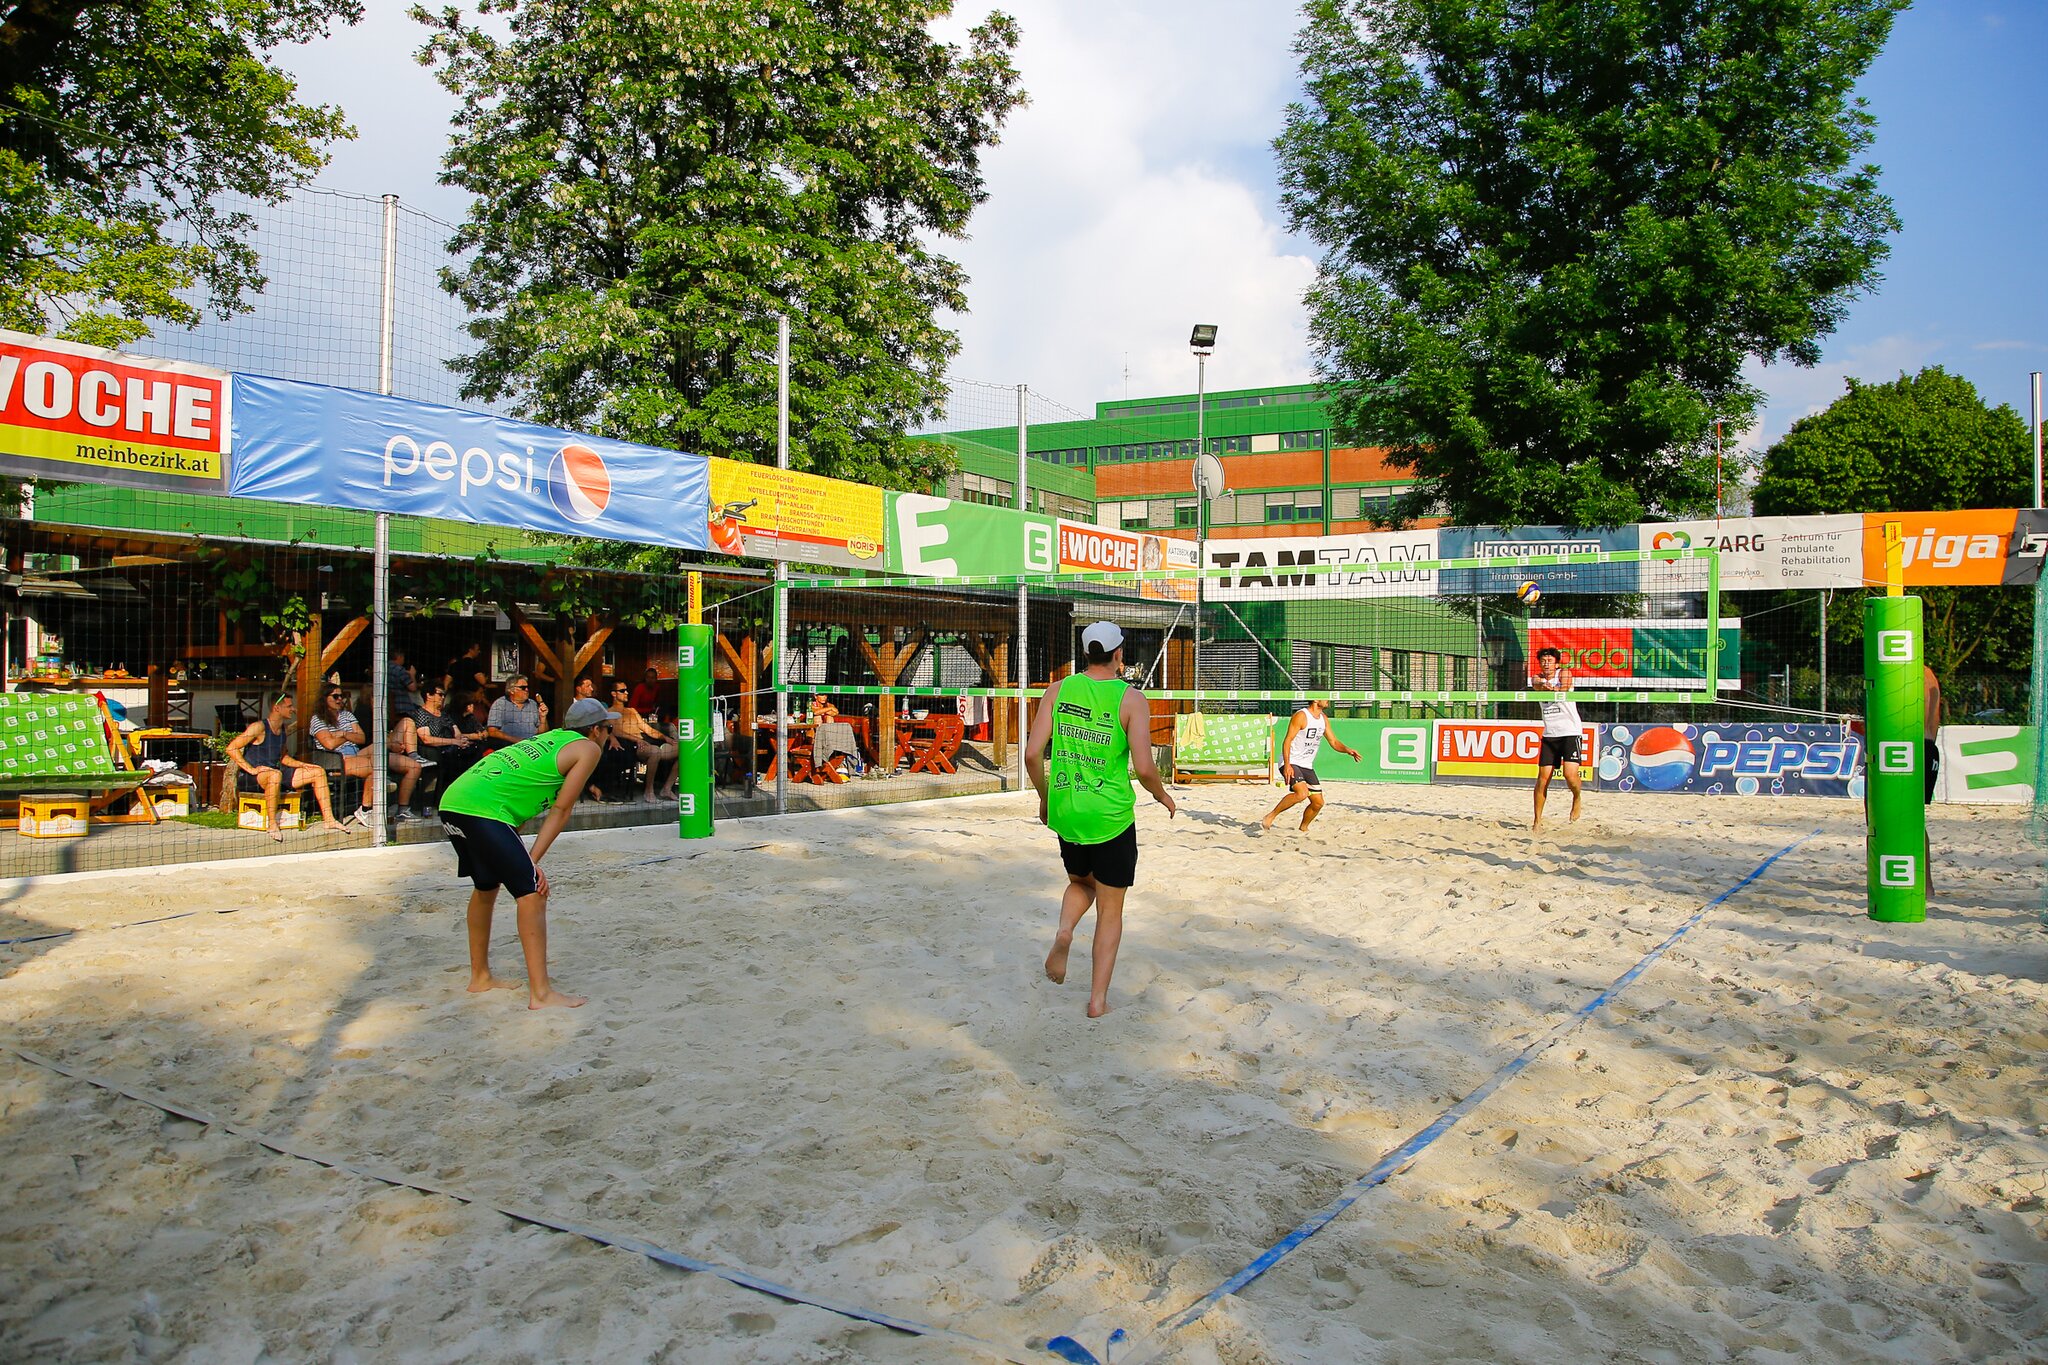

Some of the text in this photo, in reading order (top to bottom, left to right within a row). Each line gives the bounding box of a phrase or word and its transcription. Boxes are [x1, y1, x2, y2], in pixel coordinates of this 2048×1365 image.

[76, 444, 209, 472] meinbezirk.at
[383, 434, 534, 497] pepsi
[751, 471, 794, 483] FEUERLÖSCHER
[748, 487, 798, 500] NOTBELEUCHTUNG
[780, 485, 826, 497] WANDHYDRANTEN
[761, 513, 824, 528] BRANDABSCHOTTUNGEN
[790, 510, 844, 523] BRANDSCHUTZTÜREN
[778, 524, 820, 534] LÖSCHTRAINING
[1704, 534, 1764, 552] ZARG
[1781, 532, 1842, 542] Zentrum für
[850, 541, 874, 551] NORIS
[1068, 531, 1136, 570] WOCHE
[1781, 545, 1835, 553] ambulante
[1781, 555, 1851, 565] Rehabilitation
[1491, 572, 1577, 580] Immobilien GmbH
[1781, 568, 1804, 577] Graz
[1058, 723, 1111, 745] HEISSENBERGER
[1442, 730, 1450, 757] meine
[1454, 730, 1588, 760] WOC
[1700, 741, 1861, 780] PEPSI
